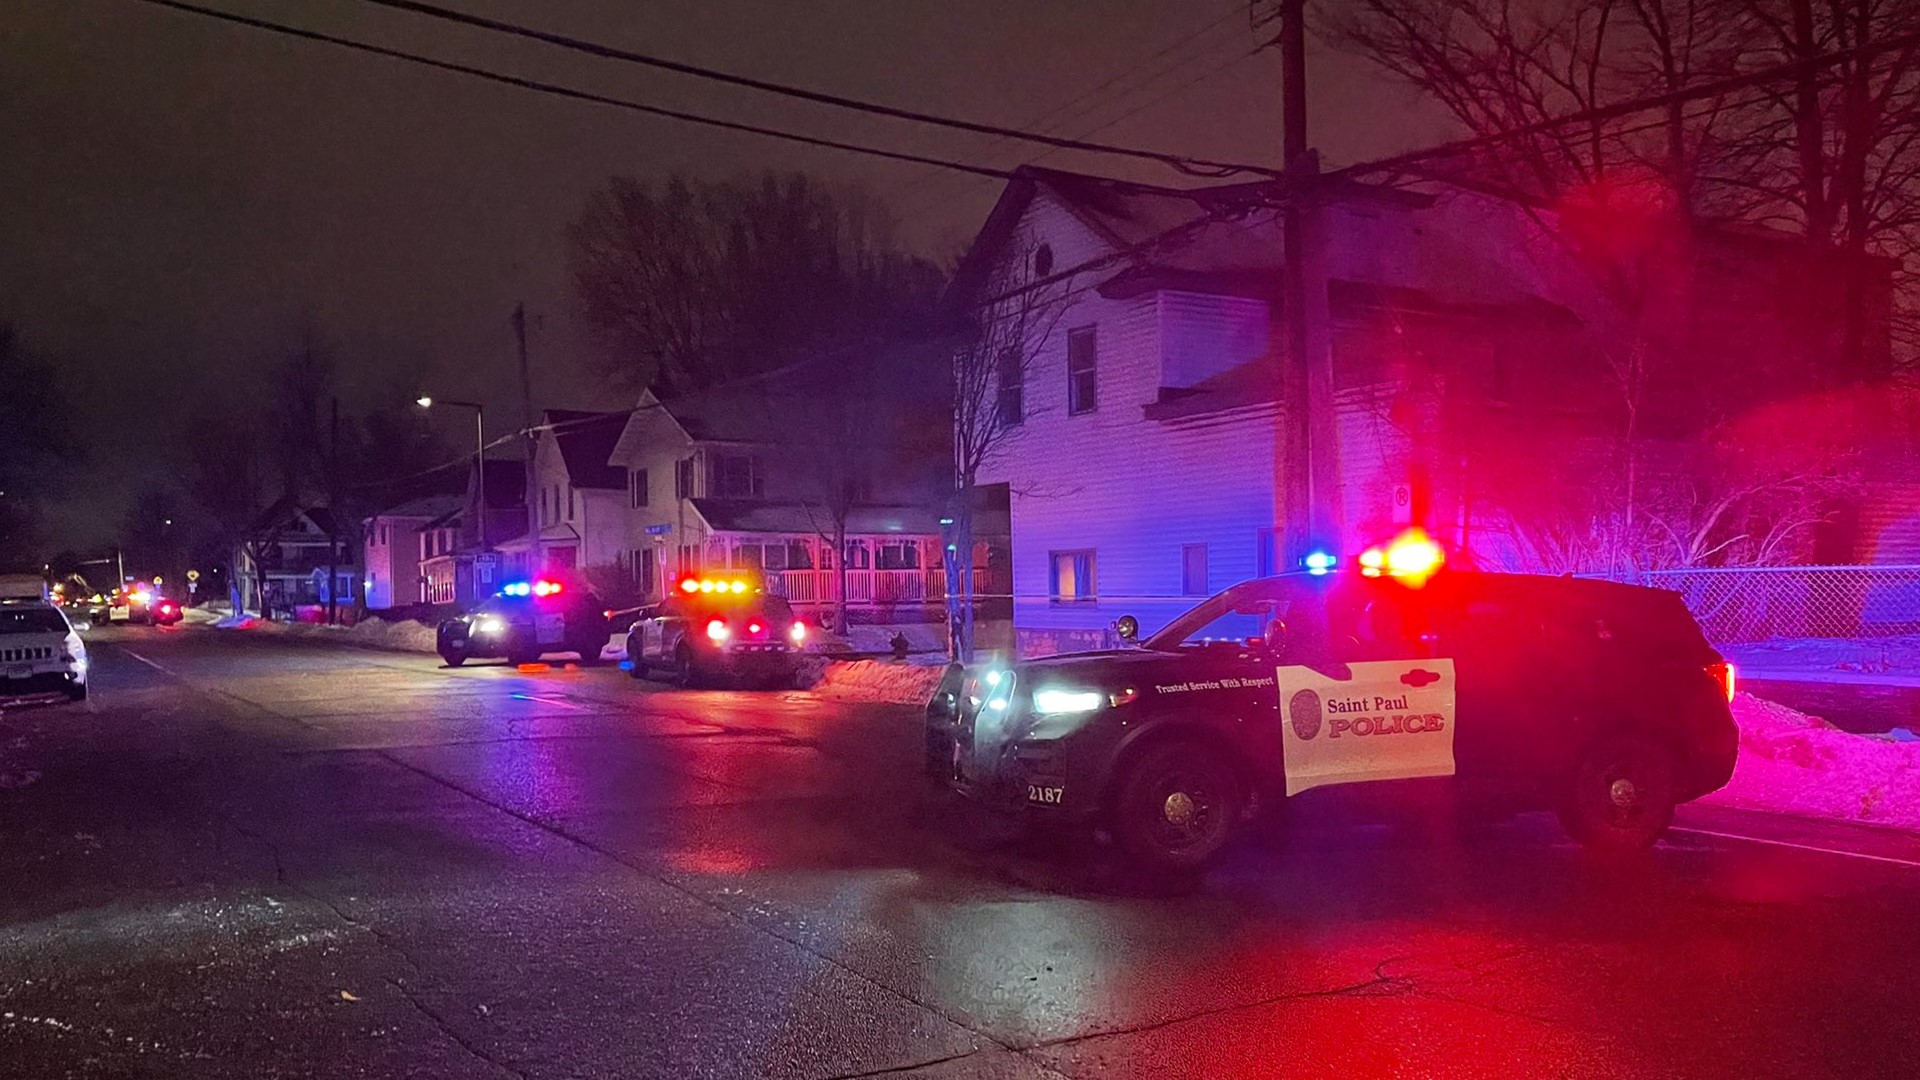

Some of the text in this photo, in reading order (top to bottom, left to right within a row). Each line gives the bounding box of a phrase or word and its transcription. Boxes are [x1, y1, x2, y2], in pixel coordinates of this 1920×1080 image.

[1155, 676, 1274, 694] Trusted Service With Respect
[1327, 695, 1409, 714] Saint Paul
[1328, 713, 1445, 738] POLICE
[1028, 785, 1063, 804] 2187
